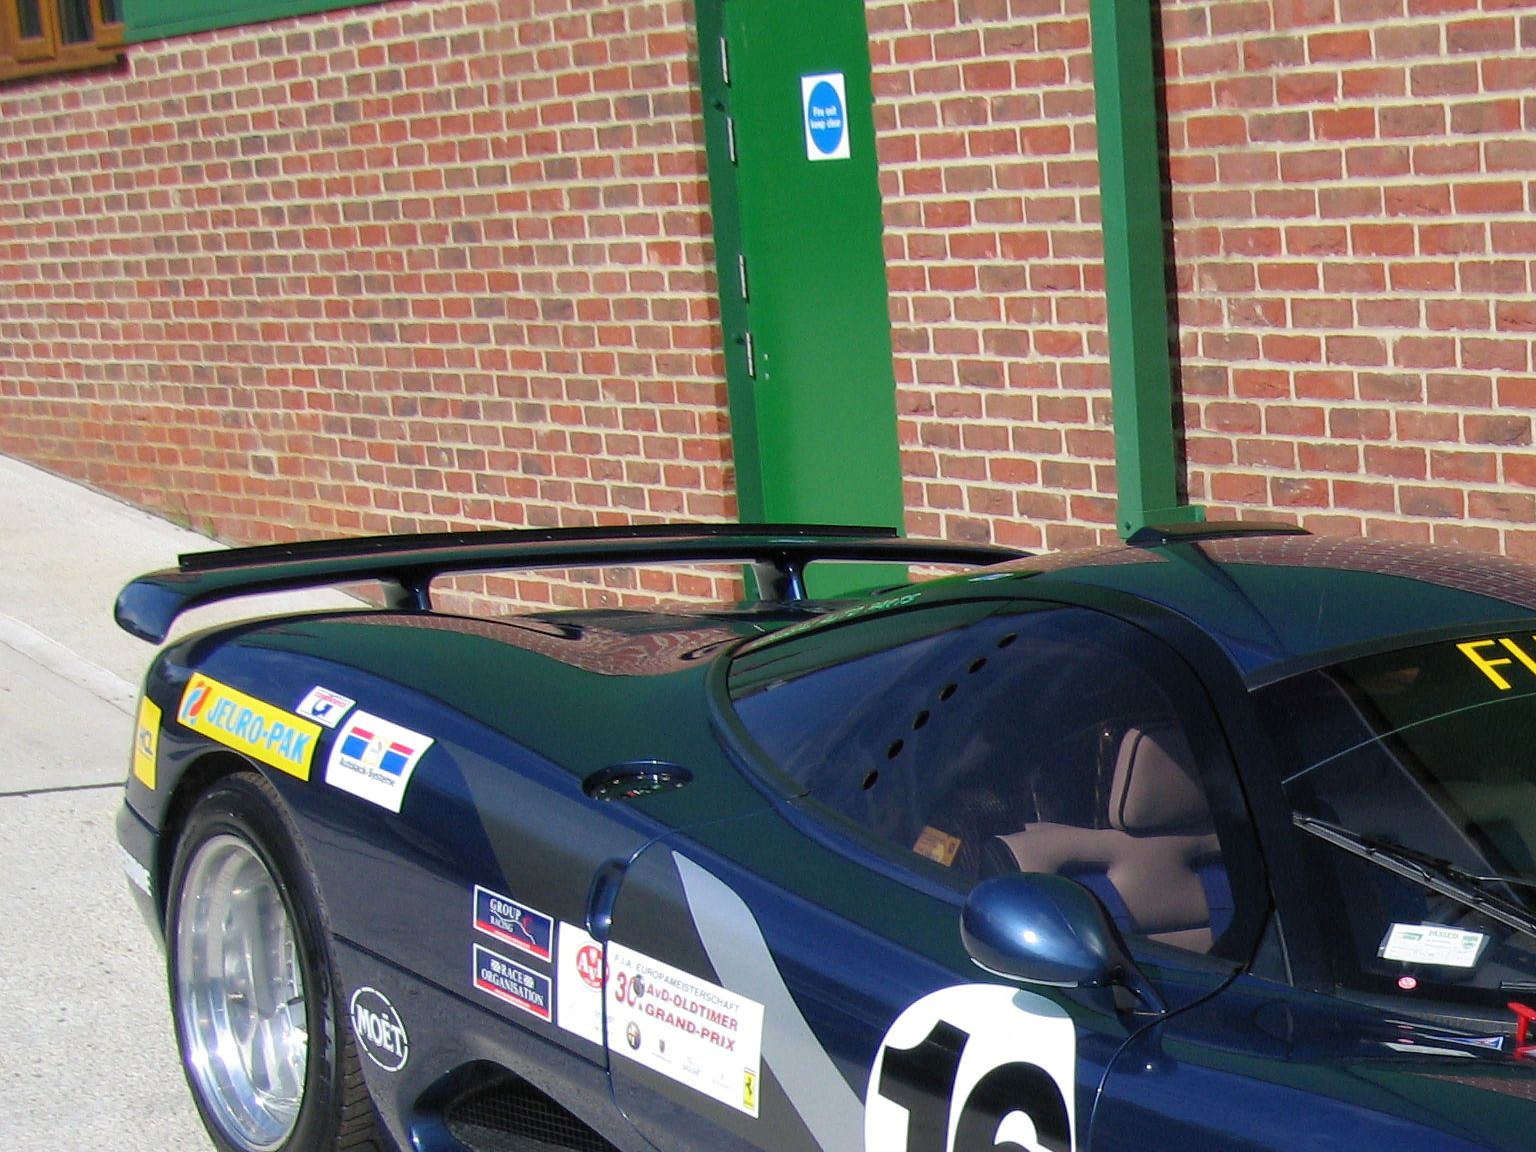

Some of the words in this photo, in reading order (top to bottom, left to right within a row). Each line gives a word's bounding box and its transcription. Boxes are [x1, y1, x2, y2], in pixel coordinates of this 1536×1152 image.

[490, 898, 521, 921] GROUP
[480, 967, 544, 1007] ORGANISATION
[646, 983, 739, 1032] AvD-OLDTIMER
[356, 1003, 404, 1058] MOËT
[644, 1003, 736, 1052] GRAND-PRIX
